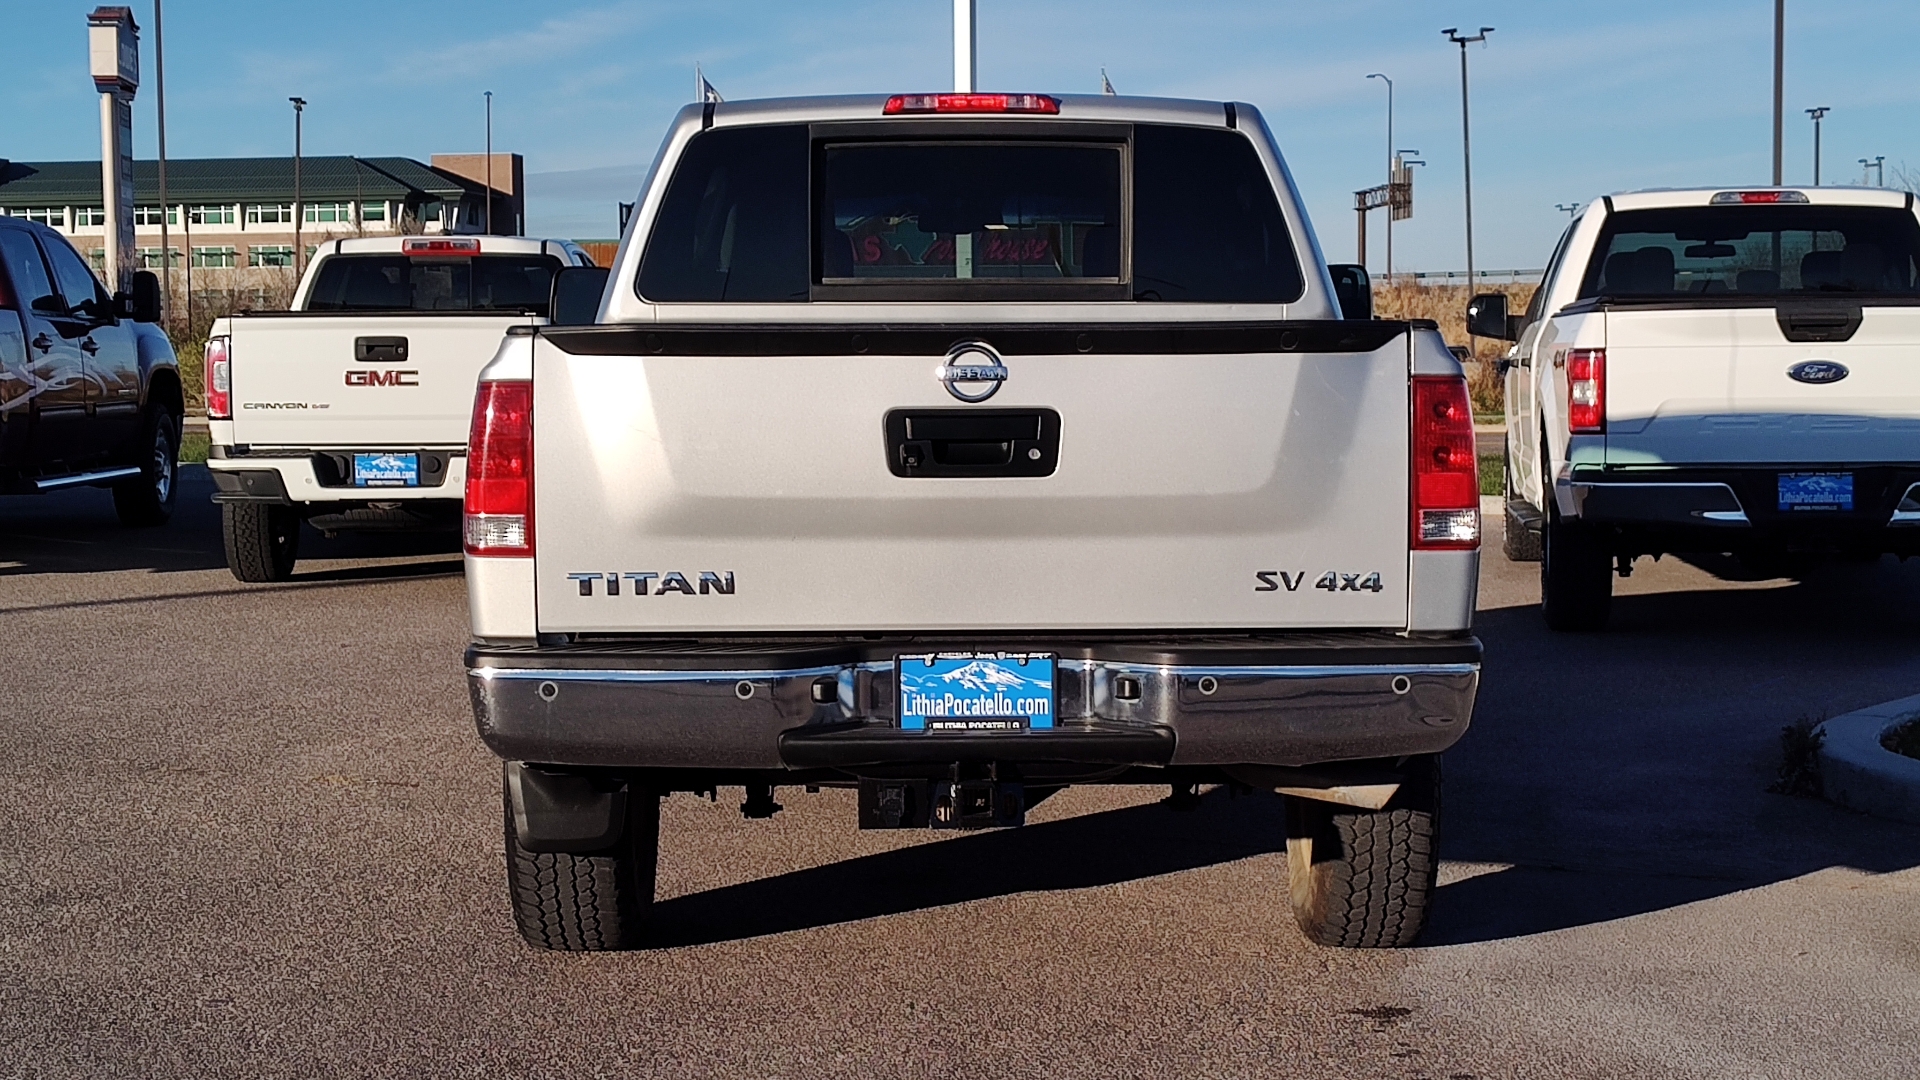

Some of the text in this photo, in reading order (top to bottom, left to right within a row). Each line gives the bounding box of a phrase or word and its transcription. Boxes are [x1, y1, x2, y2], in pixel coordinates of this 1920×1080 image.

[345, 370, 419, 386] GMC
[946, 367, 1000, 379] NISSAN
[1801, 364, 1836, 379] Ford
[566, 571, 736, 597] TITAN
[1254, 570, 1384, 593] SV 4x4
[903, 692, 1050, 716] LithiaPocatello.com
